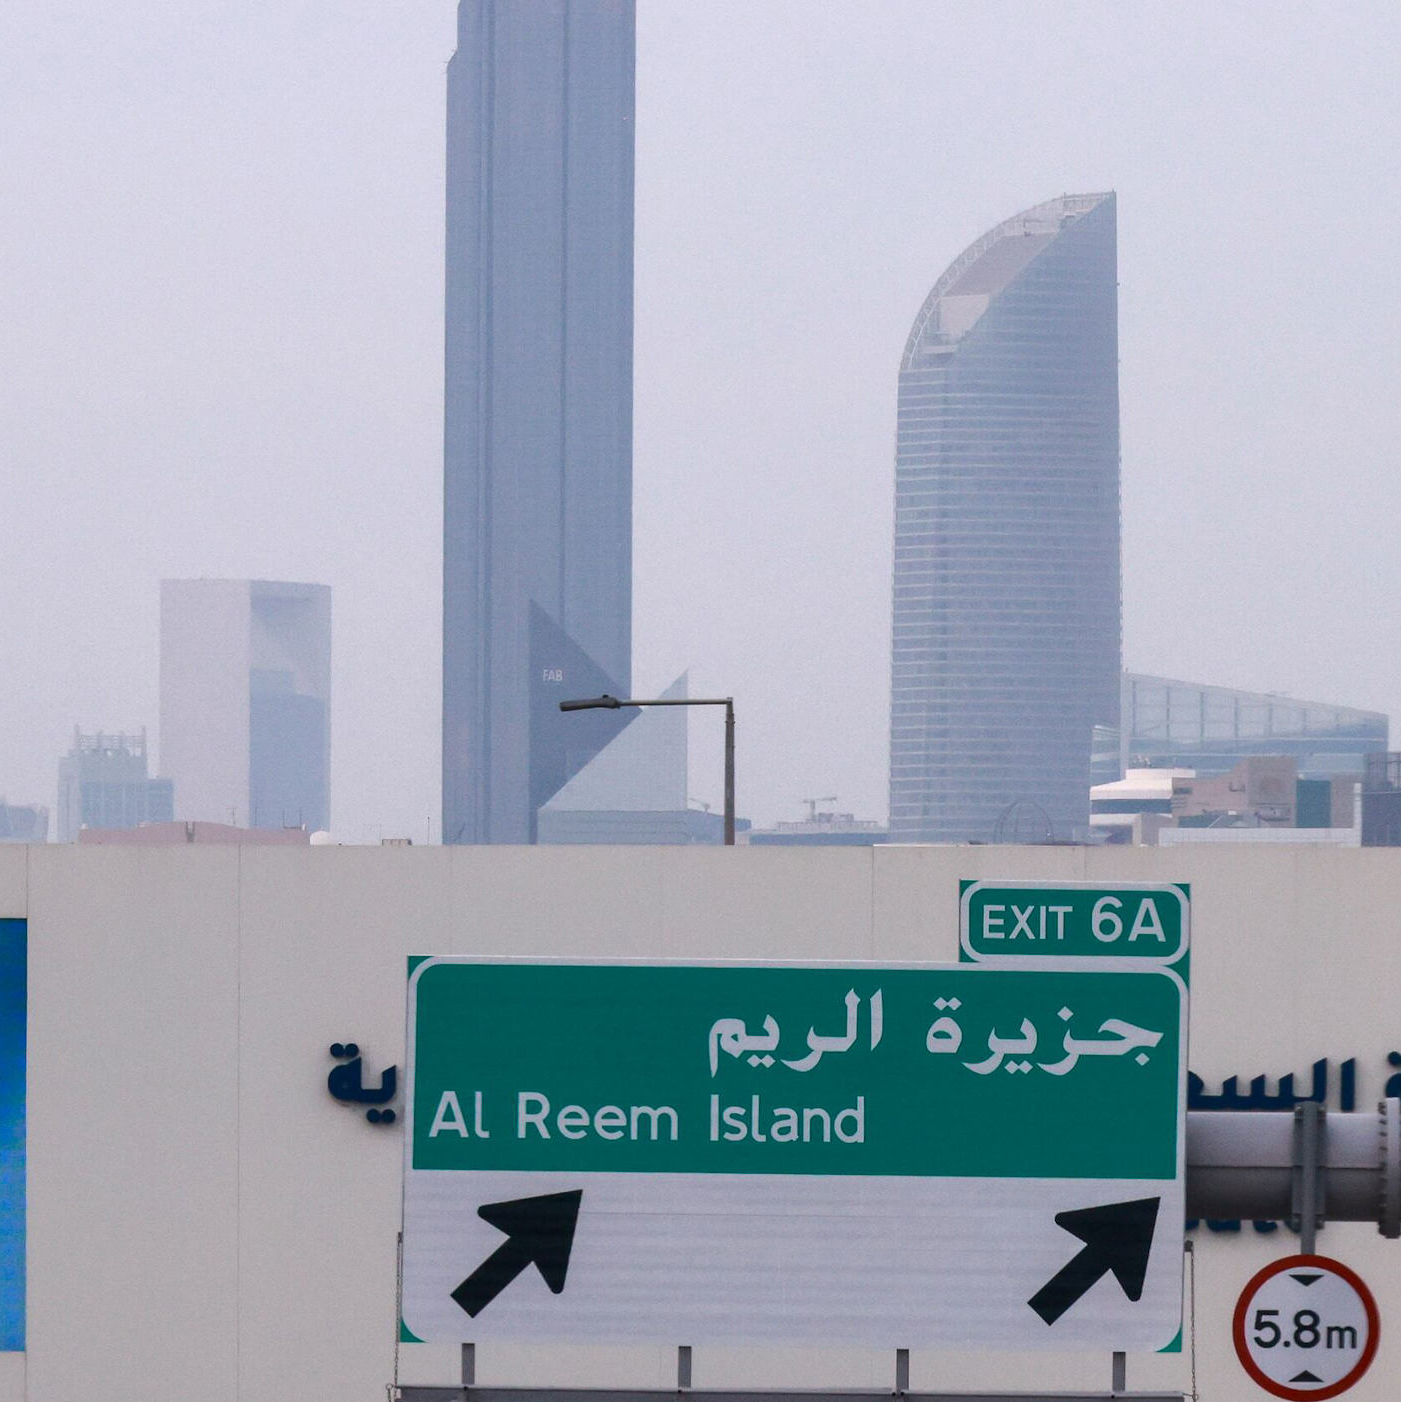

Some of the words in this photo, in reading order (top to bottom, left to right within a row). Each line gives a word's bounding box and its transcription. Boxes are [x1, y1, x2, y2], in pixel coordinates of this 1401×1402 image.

[542, 669, 563, 681] FAB
[982, 904, 1074, 941] EXIT
[1091, 896, 1167, 944] 6A
[709, 987, 884, 1079] الريم
[926, 996, 1165, 1076] جزيرة
[428, 1090, 490, 1141] Al
[517, 1091, 680, 1142] Reem
[709, 1095, 866, 1145] Island
[1254, 1309, 1357, 1349] 5.8m
